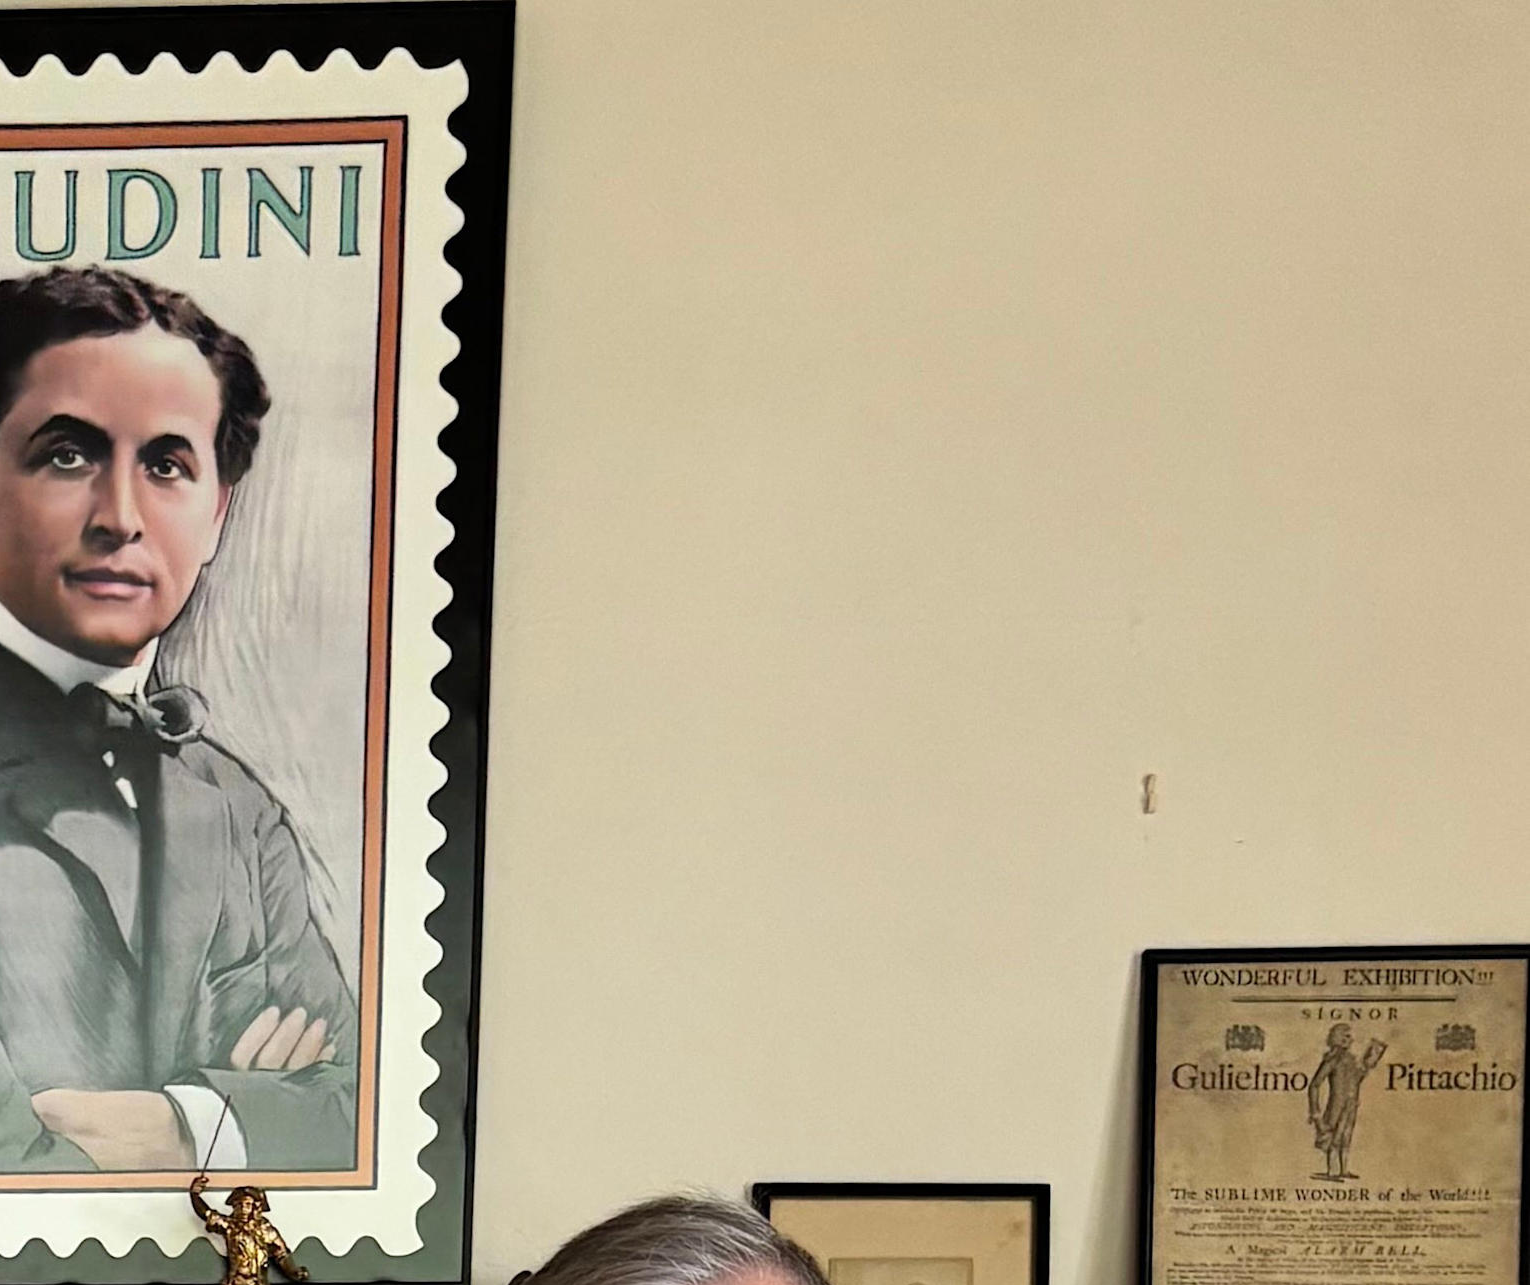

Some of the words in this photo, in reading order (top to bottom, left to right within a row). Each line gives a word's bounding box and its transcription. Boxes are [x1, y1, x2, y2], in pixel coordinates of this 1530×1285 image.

[1181, 968, 1327, 987] WONDERFUL
[1301, 1007, 1400, 1021] SIGNOR
[1171, 1062, 1309, 1092] Gulielmo
[1384, 1061, 1518, 1092] Pittachio
[1170, 1188, 1198, 1200] The
[1204, 1188, 1287, 1201] SUBLIME
[1295, 1188, 1370, 1201] WONDER
[1378, 1188, 1394, 1201] of
[1401, 1189, 1421, 1201] the
